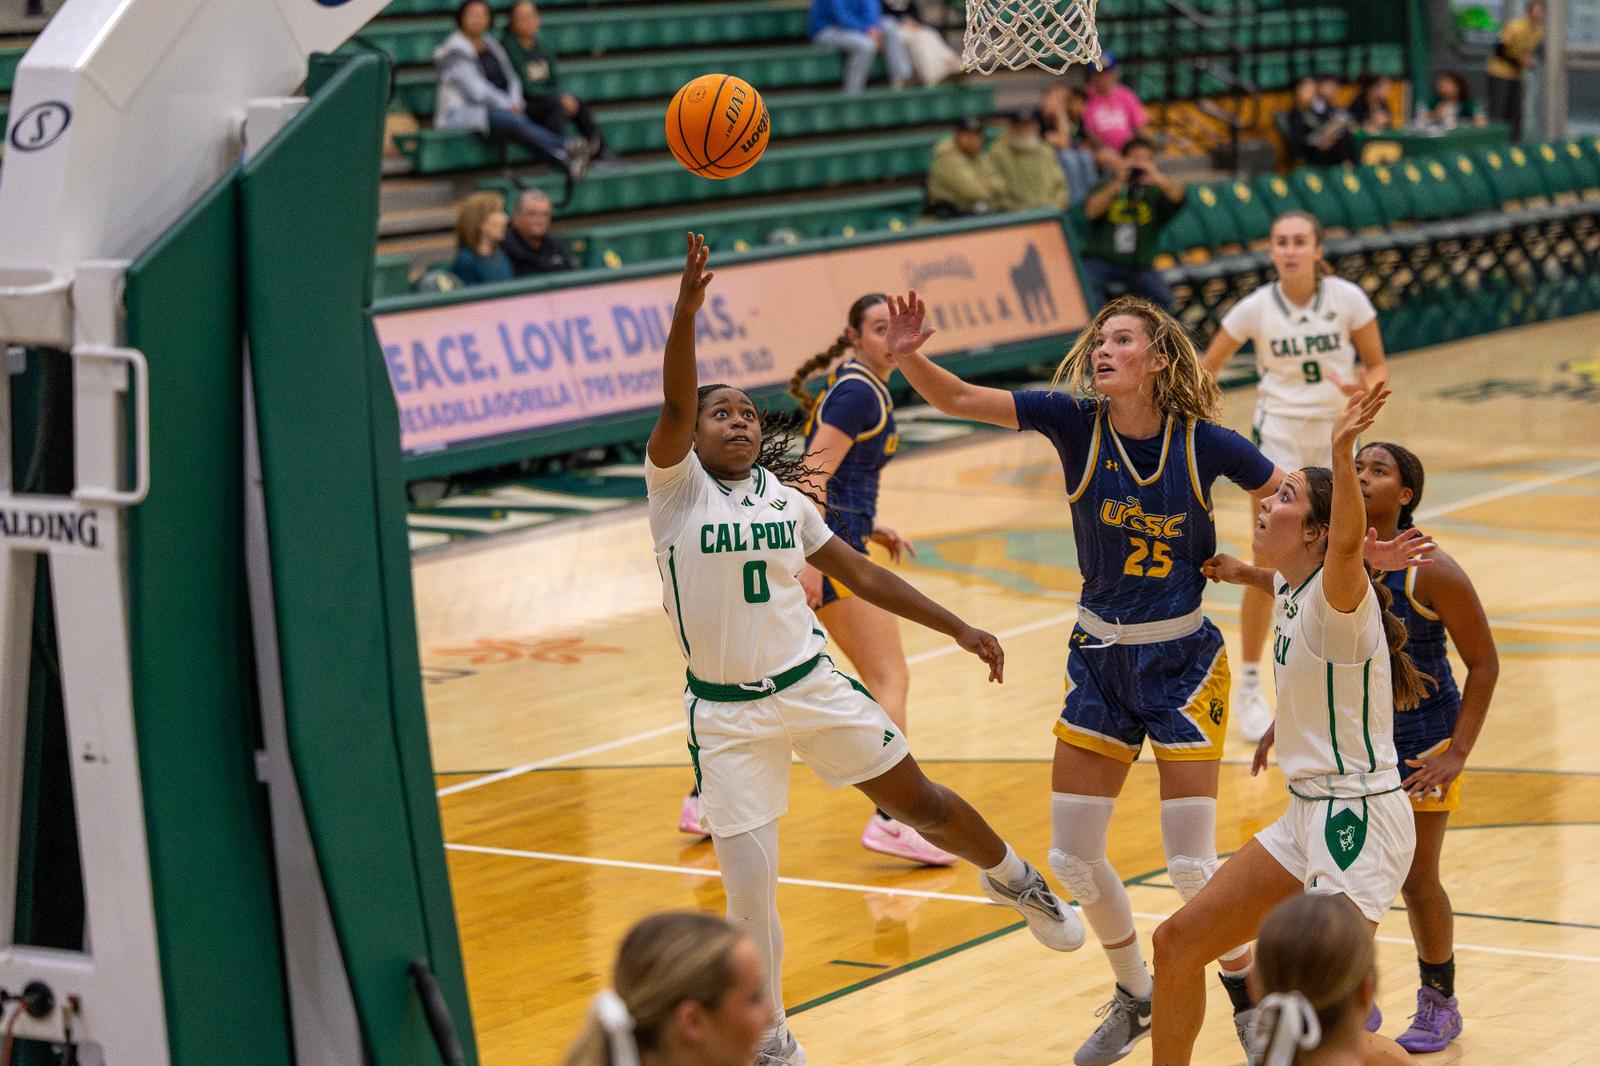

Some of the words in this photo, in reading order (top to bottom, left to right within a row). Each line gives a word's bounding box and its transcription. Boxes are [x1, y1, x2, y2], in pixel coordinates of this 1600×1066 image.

[725, 86, 746, 124] EVO
[497, 314, 612, 376] LOVE.
[612, 296, 747, 358] DILAS.
[1270, 336, 1302, 358] CAL
[1304, 333, 1341, 356] POLY
[1302, 361, 1322, 384] 9
[1100, 496, 1187, 539] UCSC
[700, 522, 747, 554] CAL
[750, 520, 797, 551] POLY
[1123, 536, 1174, 578] 25
[743, 560, 771, 604] 0
[1274, 634, 1292, 666] LY
